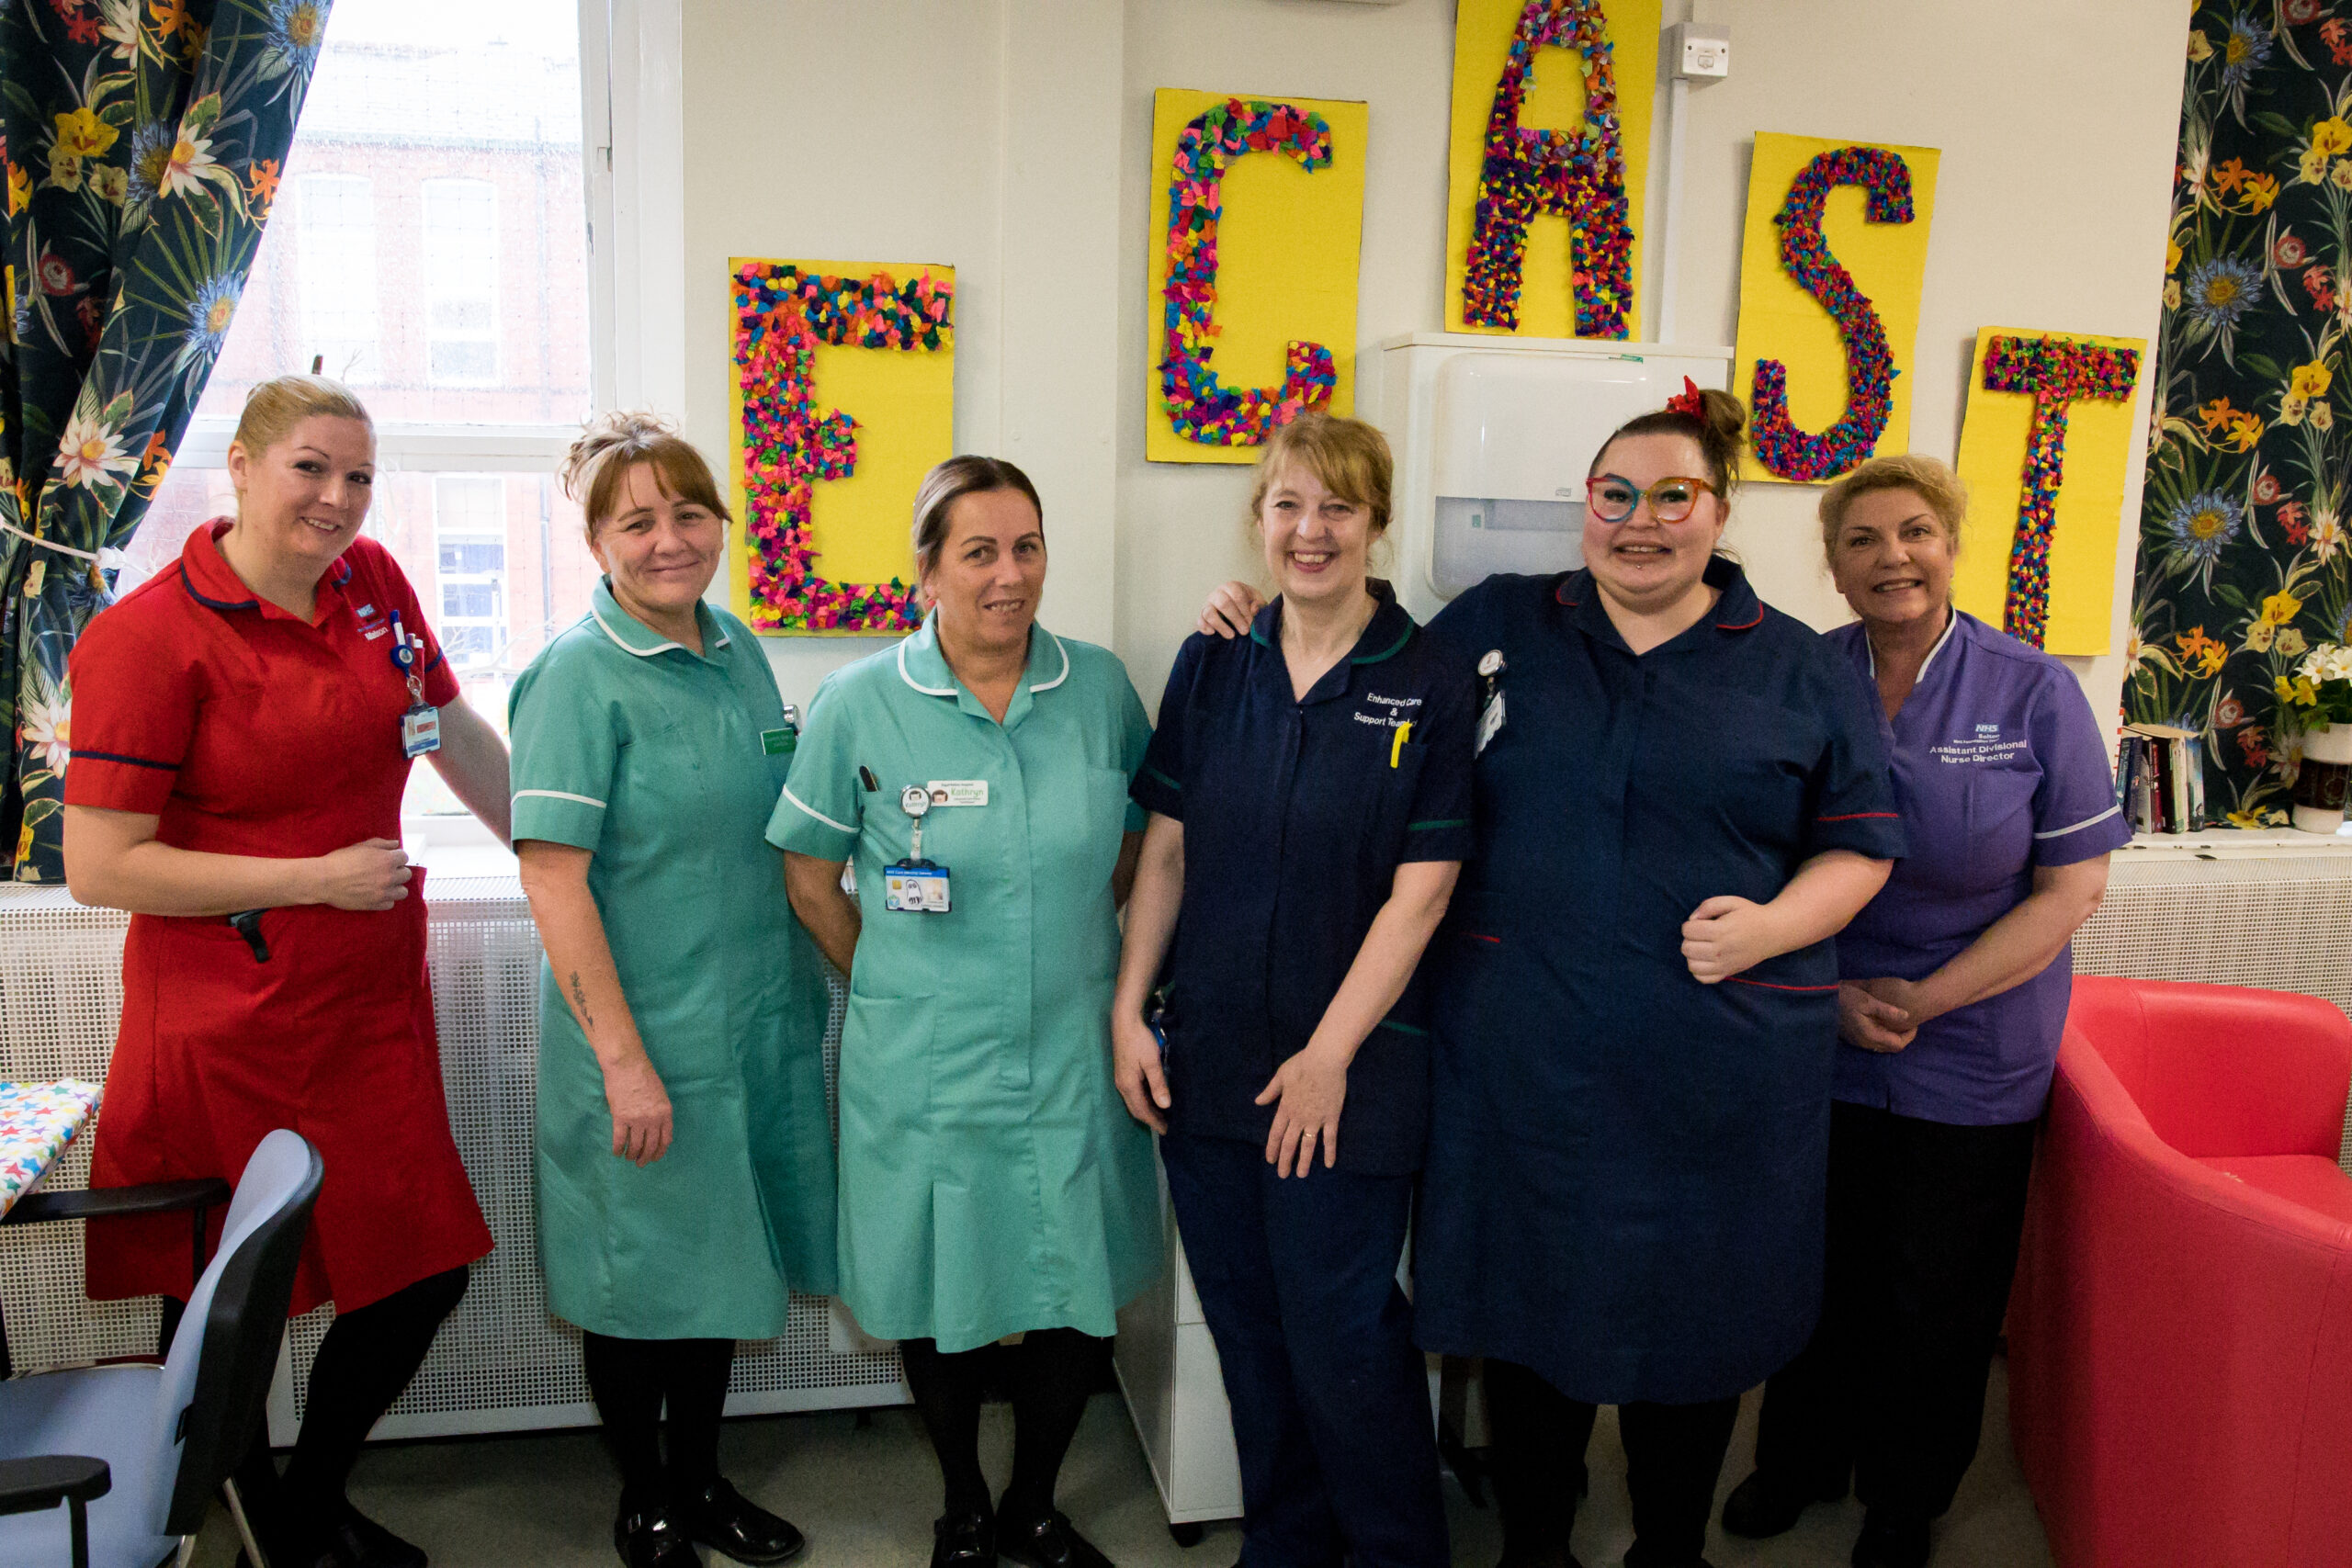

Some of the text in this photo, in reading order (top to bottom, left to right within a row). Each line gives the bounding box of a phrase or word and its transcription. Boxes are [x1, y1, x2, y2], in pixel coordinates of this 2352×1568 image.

[1367, 692, 1406, 706] Enhanced
[1390, 707, 1398, 716] &
[1353, 711, 1386, 726] Support
[1975, 724, 1999, 733] NHS
[1929, 739, 2027, 755] Assistant Divisional
[1941, 751, 2015, 763] Nurse Director
[951, 787, 984, 798] Kathryn
